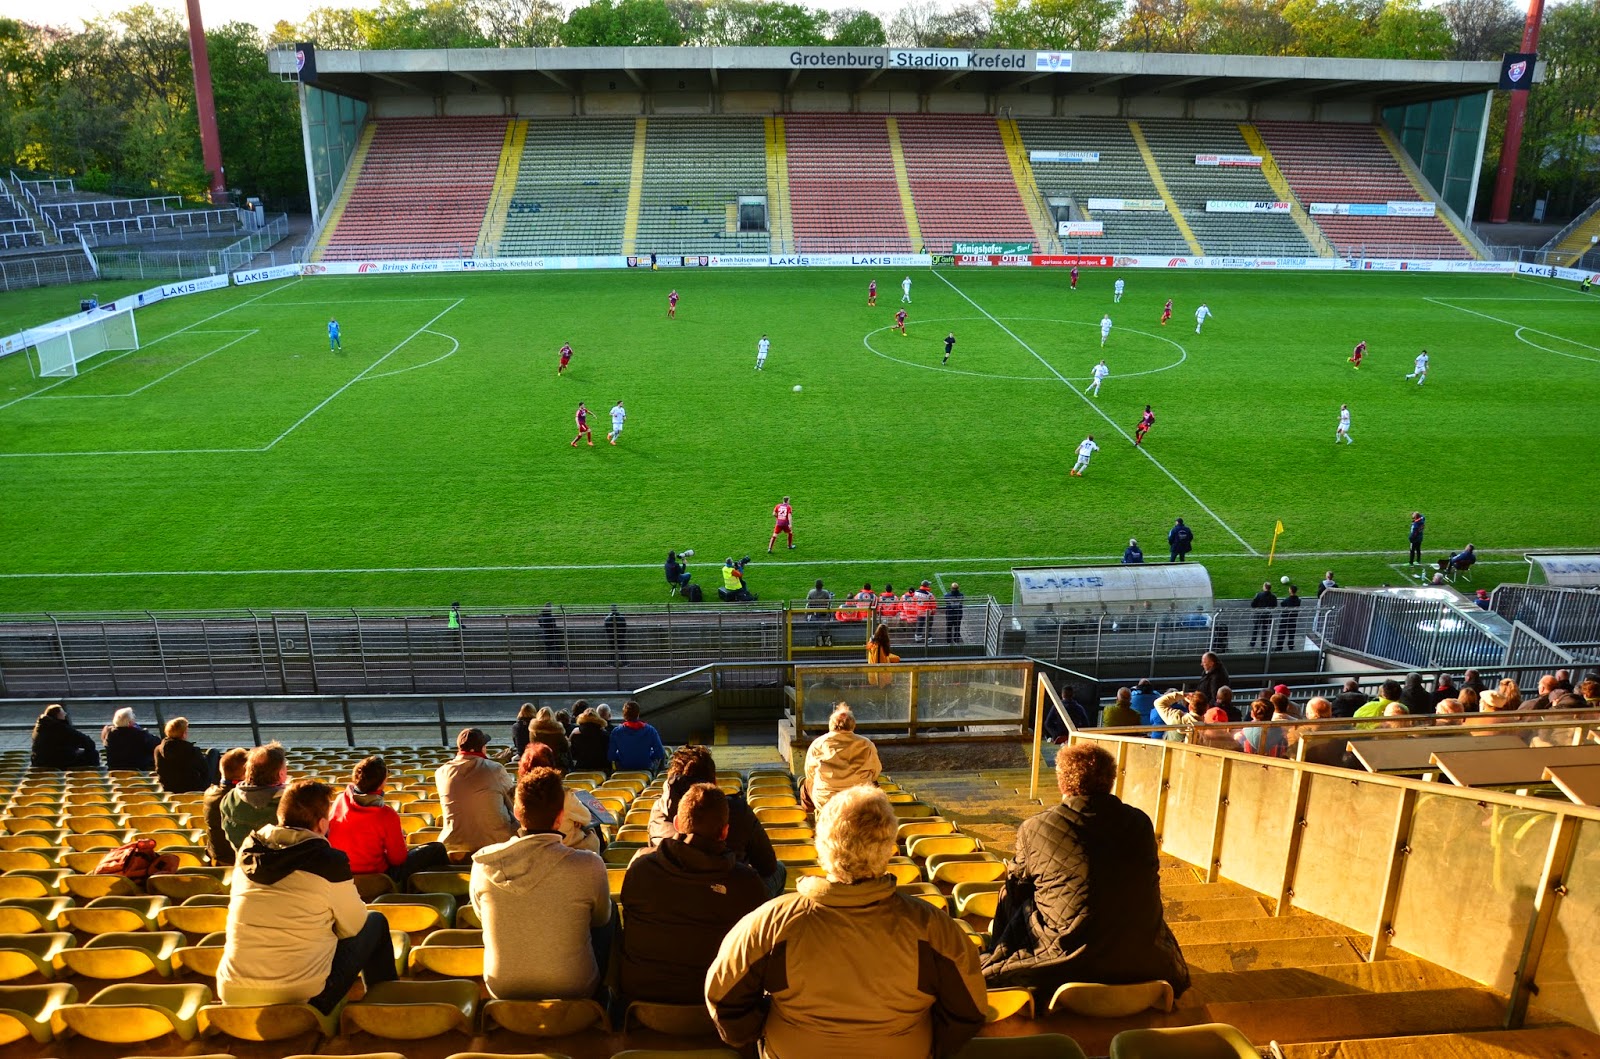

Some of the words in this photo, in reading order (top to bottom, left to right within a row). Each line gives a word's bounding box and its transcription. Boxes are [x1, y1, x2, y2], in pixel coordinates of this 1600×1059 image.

[967, 50, 1026, 69] Krefeld
[955, 243, 1003, 255] Königshofer
[769, 256, 809, 265] LAKIS
[851, 256, 891, 265] LAKIS
[962, 254, 989, 262] OTTEN
[1002, 254, 1029, 262] OTTEN
[382, 263, 409, 272] Brings
[475, 260, 508, 268] Volksbank
[236, 271, 269, 283] LAKIS
[162, 283, 196, 297] LAKIS
[778, 508, 787, 517] 23
[1024, 577, 1103, 590] LAKIS
[285, 638, 295, 650] D
